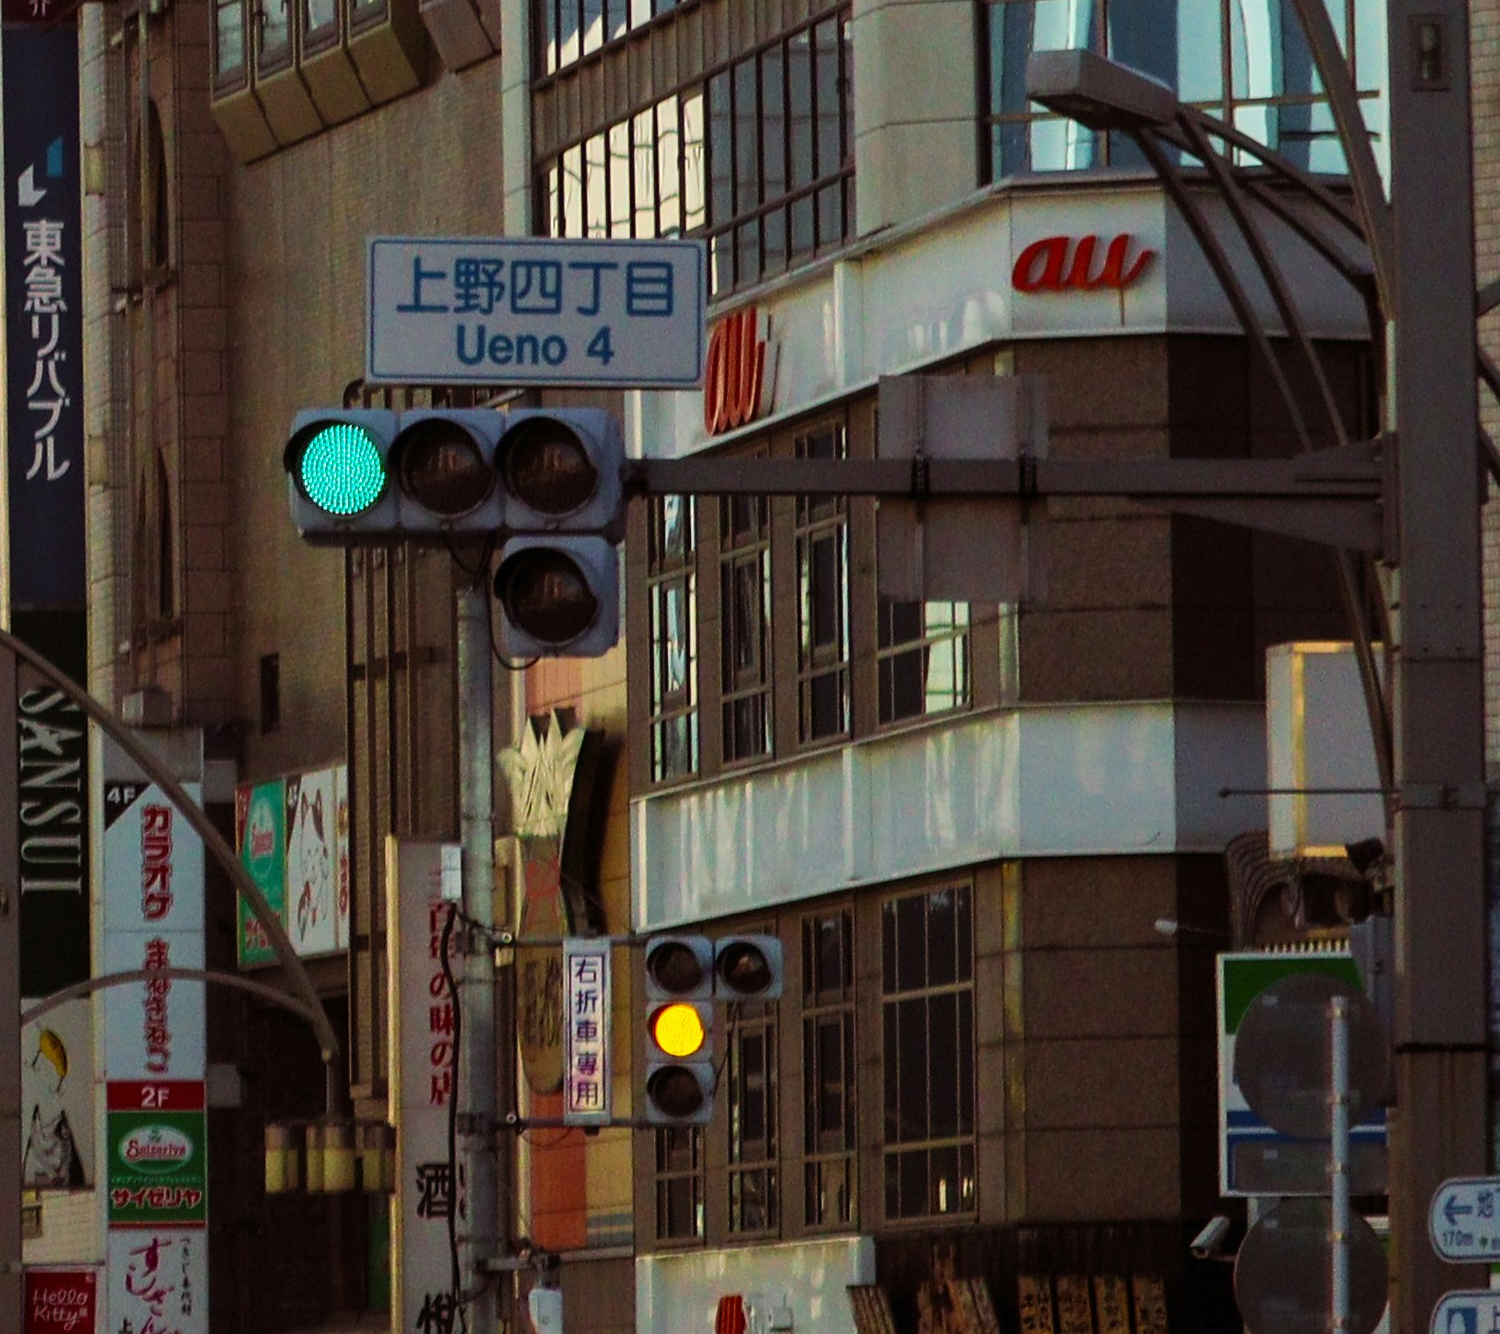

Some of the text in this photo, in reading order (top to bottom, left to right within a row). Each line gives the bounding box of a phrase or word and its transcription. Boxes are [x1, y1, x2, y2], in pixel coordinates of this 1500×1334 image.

[395, 255, 677, 320] 上野四丁目
[1011, 230, 1157, 294] au
[23, 218, 71, 482] 東急リバブル
[454, 323, 616, 367] Ueno 4
[18, 689, 82, 896] SANSUI
[107, 787, 136, 805] 4F
[141, 804, 173, 923] カラオケ
[143, 938, 171, 1074] まねきねこ
[573, 958, 600, 1109] 右折車専用
[140, 1087, 170, 1108] 2F
[125, 1139, 187, 1163] Saizeriya
[110, 1185, 202, 1210] サイゼリヤ
[32, 1288, 89, 1308] Hello
[33, 1305, 79, 1332] Kitty
